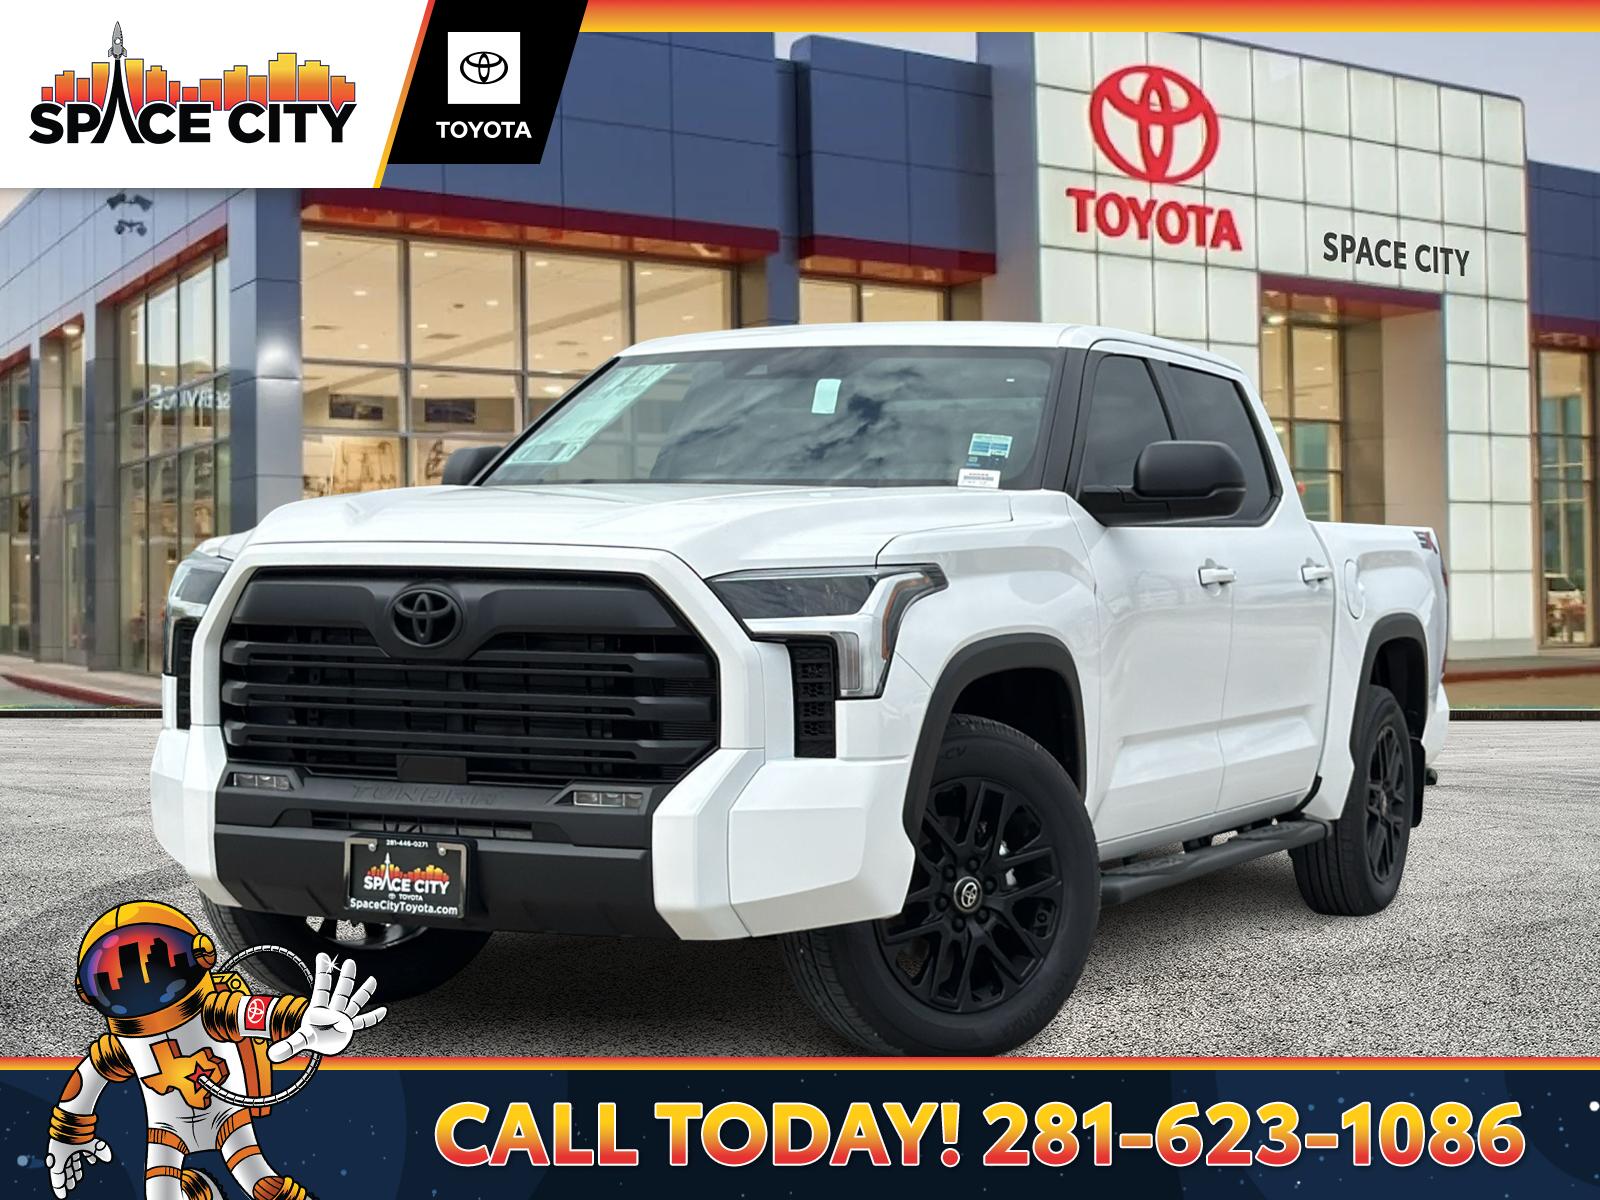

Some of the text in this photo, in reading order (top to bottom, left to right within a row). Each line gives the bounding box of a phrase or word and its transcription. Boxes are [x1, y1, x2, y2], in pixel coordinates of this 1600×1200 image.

[1066, 188, 1242, 251] TOYOTA
[1323, 232, 1470, 277] SPACE CITY
[351, 783, 501, 806] TUNDRA
[363, 875, 450, 895] SPACE CITY
[350, 897, 458, 916] SpaceCityToyota.com
[399, 893, 424, 902] TOYOTA
